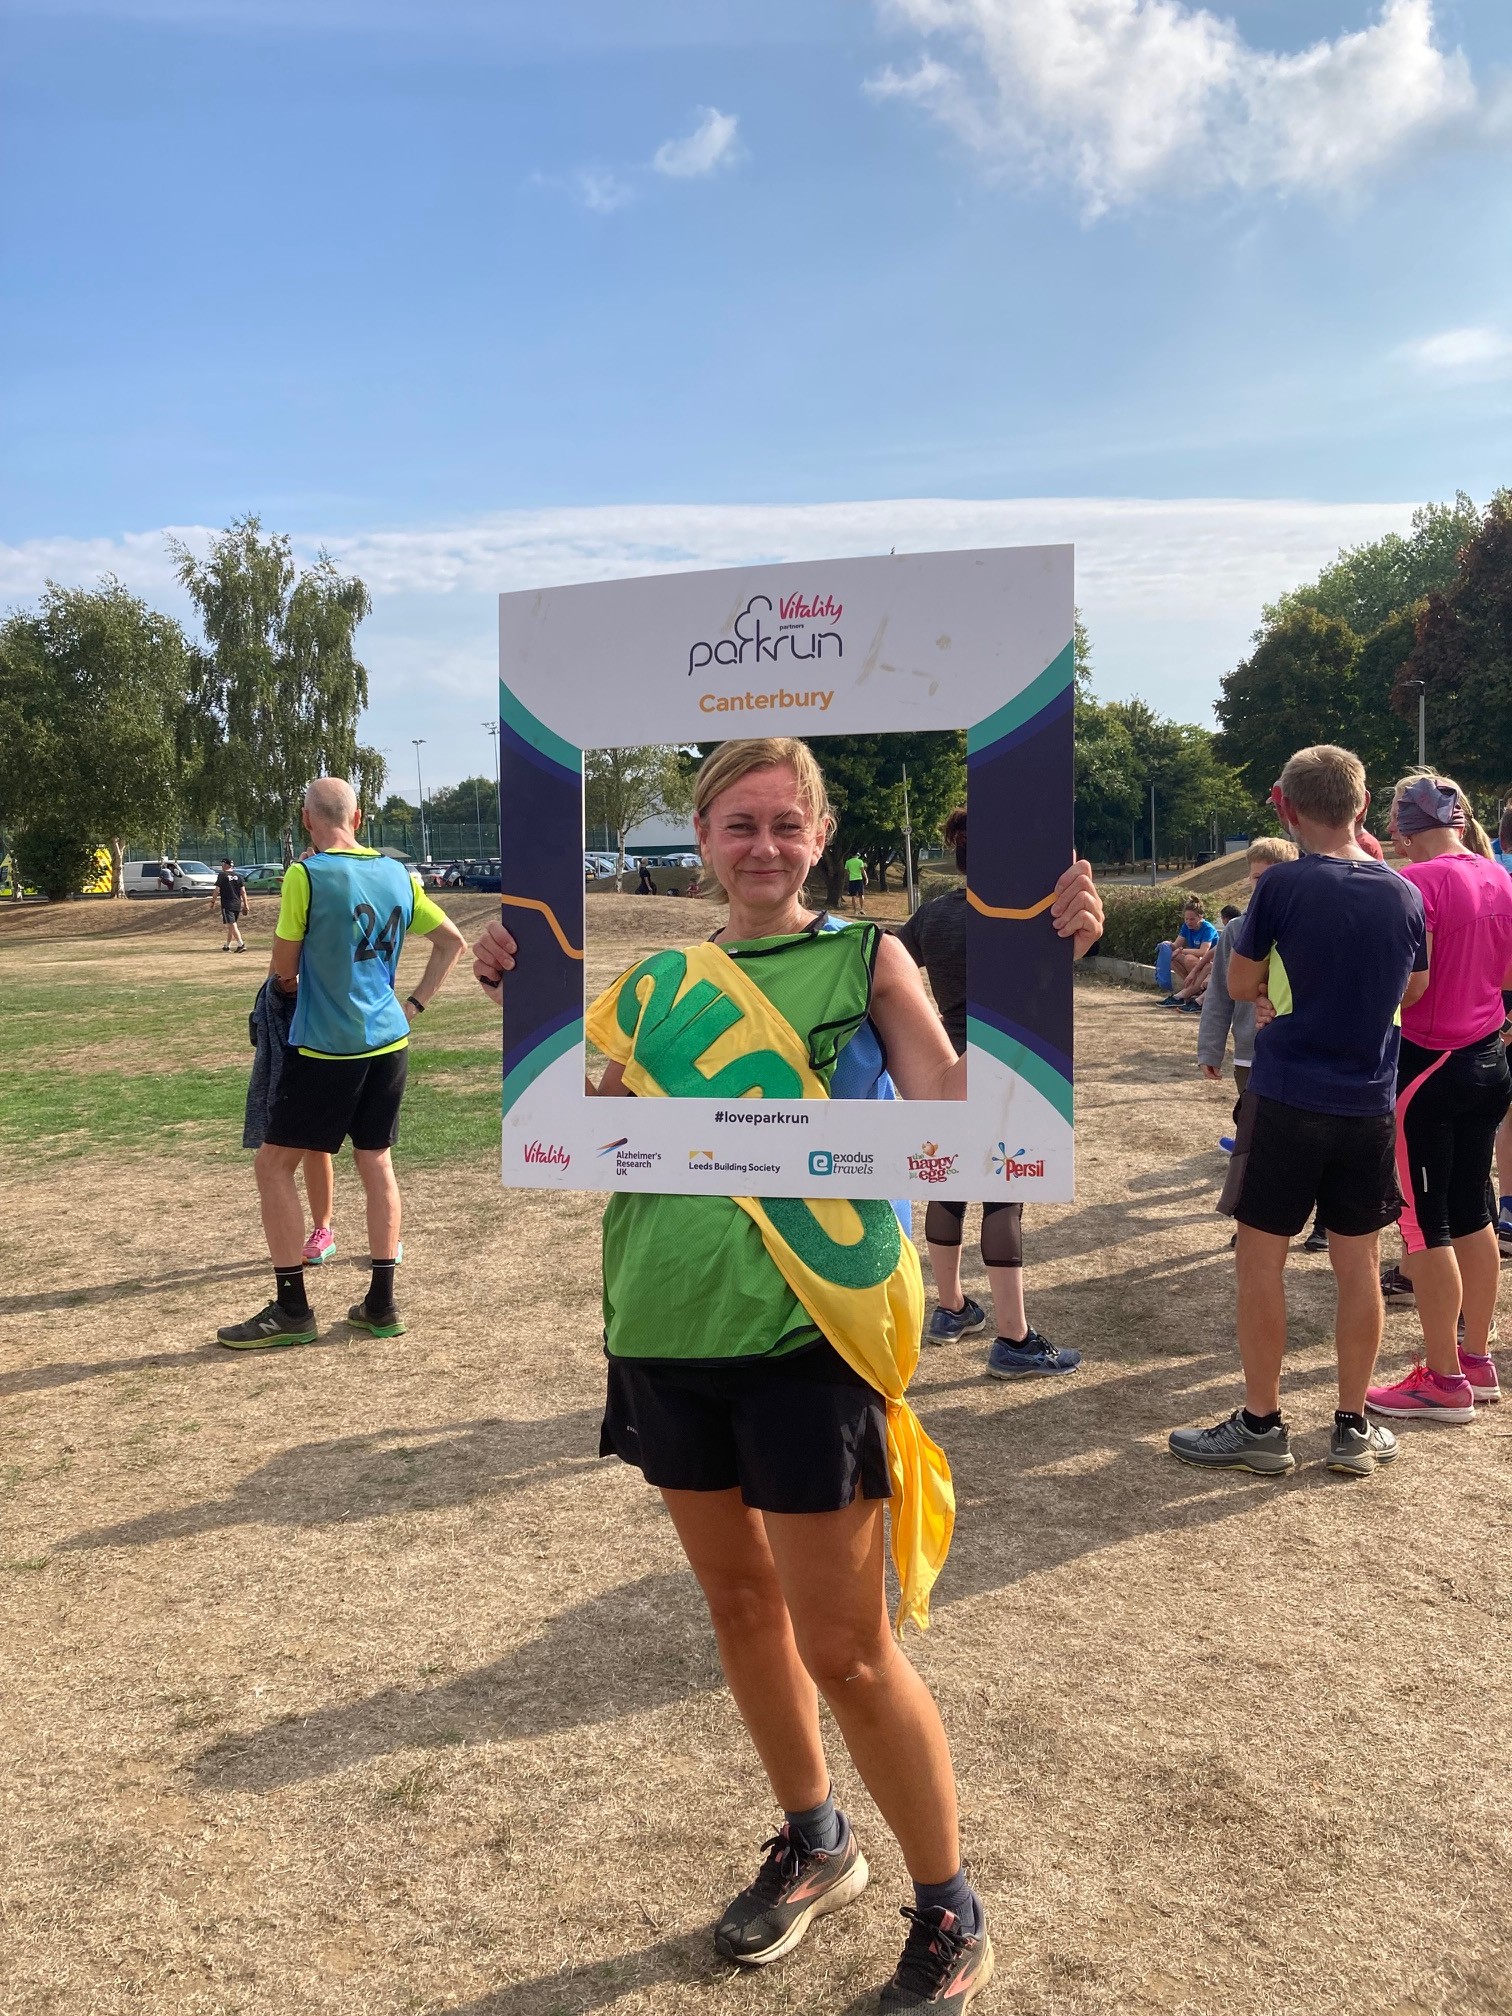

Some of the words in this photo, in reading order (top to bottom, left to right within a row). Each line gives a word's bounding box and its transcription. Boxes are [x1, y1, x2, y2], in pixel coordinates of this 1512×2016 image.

[779, 591, 843, 625] Vitality
[688, 619, 843, 676] parkrun
[699, 689, 834, 713] Canterbury
[353, 904, 403, 963] 24
[714, 1111, 809, 1126] #loveparkrun
[524, 1140, 571, 1171] Vitality
[616, 1151, 662, 1160] Alzheimer's
[833, 1151, 874, 1163] exodus
[907, 1154, 959, 1171] happy
[616, 1160, 652, 1168] Research
[689, 1162, 713, 1170] Leeds
[714, 1162, 747, 1173] Building
[748, 1163, 781, 1173] Society
[833, 1162, 874, 1175] travels
[1006, 1159, 1044, 1181] Persil
[616, 1168, 628, 1176] UK
[919, 1168, 947, 1183] egg
